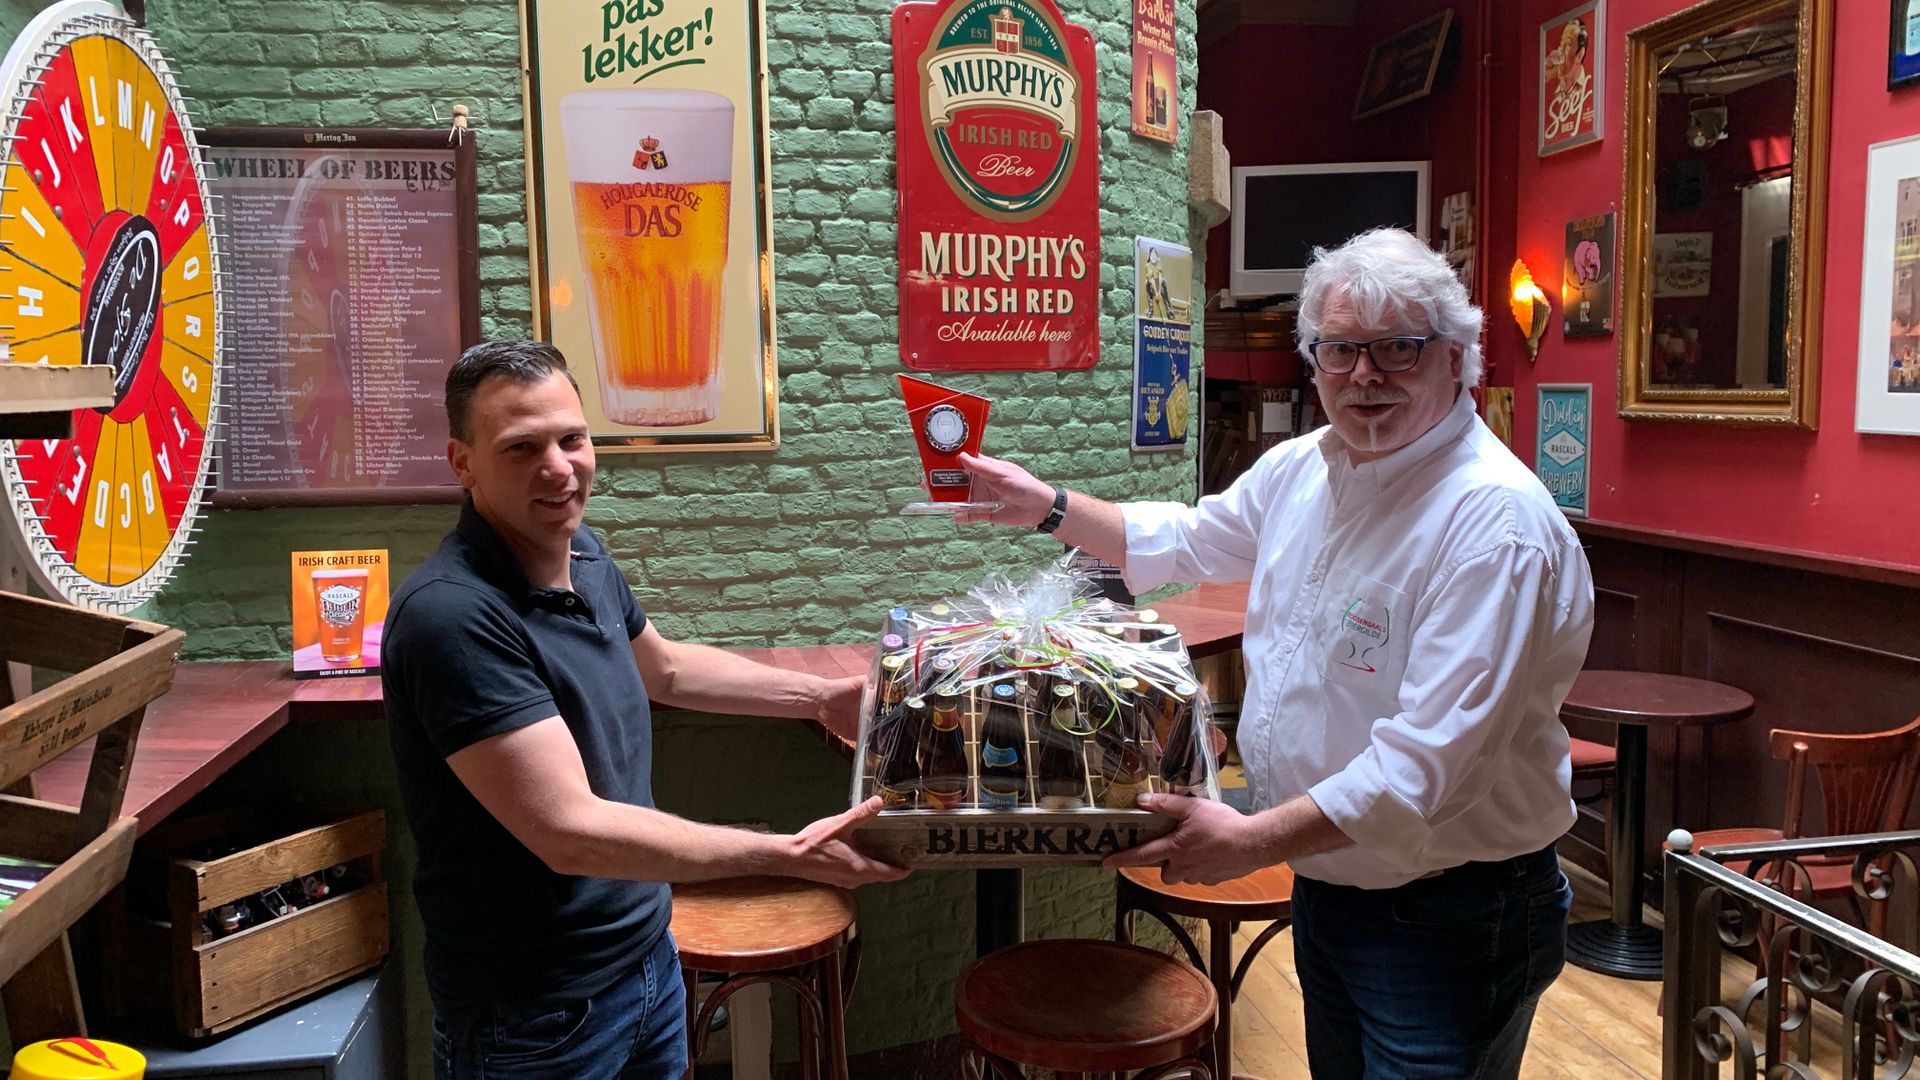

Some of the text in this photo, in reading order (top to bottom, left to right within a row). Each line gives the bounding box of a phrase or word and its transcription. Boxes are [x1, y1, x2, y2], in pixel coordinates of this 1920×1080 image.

[600, 0, 665, 42] pas
[968, 7, 976, 16] TO
[976, 2, 988, 10] THE
[1017, 3, 1034, 19] RECIPE
[1034, 18, 1049, 34] SINCE
[970, 28, 989, 39] EST.
[582, 7, 714, 83] lekker!
[940, 58, 1064, 109] MURPHY'S
[117, 79, 132, 130] M
[60, 96, 84, 153] K
[140, 100, 156, 150] N
[315, 133, 341, 142] Hertog
[959, 124, 1053, 151] IRISH RED
[40, 138, 61, 189] J
[210, 158, 456, 181] WHEEL OF BEERS
[976, 153, 1036, 178] Beer
[600, 181, 702, 212] HOUGAERDSE
[624, 204, 682, 238] DAS
[920, 230, 1086, 282] MURPHY'S
[941, 286, 1075, 315] IRISH RED
[937, 316, 1072, 342] Available here
[1543, 398, 1586, 432] Dublin
[1551, 444, 1577, 454] RASCALS
[1541, 467, 1584, 497] BREWERY
[299, 555, 381, 566] IRISH CRAFT BEER
[926, 821, 1138, 854] BIERKRAT
